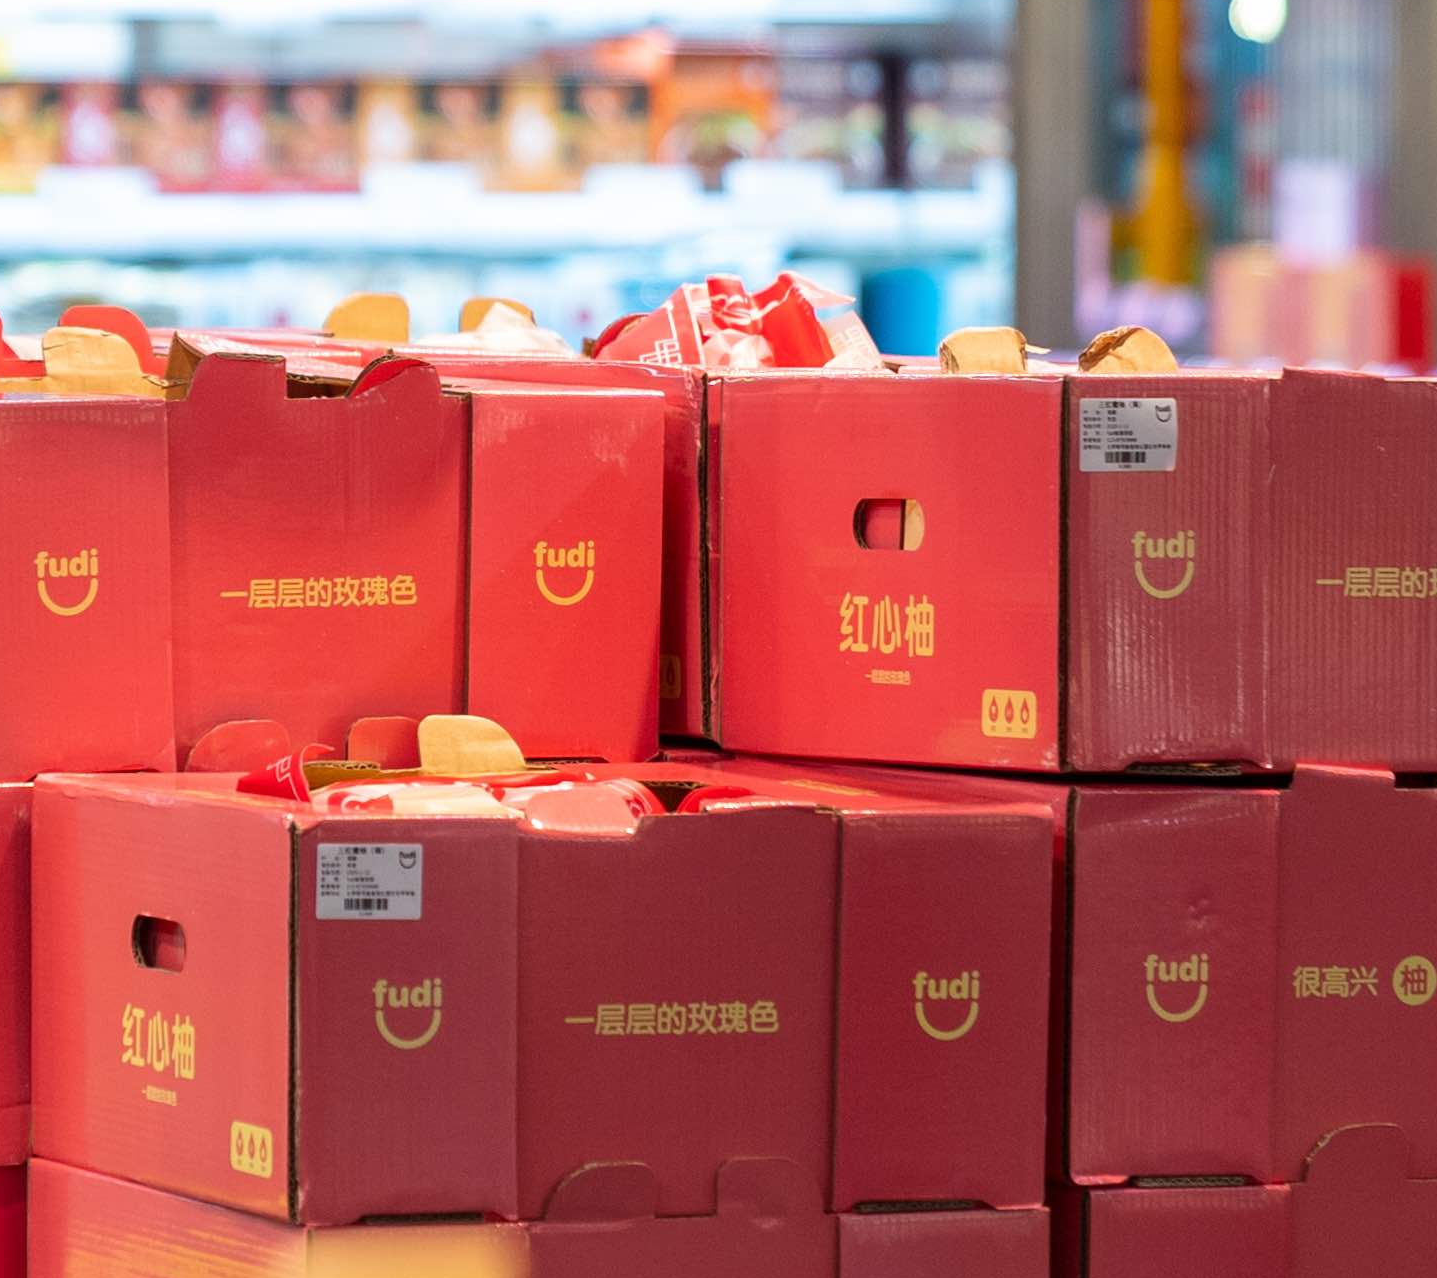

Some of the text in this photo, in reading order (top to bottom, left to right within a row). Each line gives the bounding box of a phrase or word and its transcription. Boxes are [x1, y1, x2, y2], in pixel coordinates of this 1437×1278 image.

[534, 540, 595, 568] fudi
[1131, 530, 1197, 559] fudi
[35, 548, 99, 577] fudi
[220, 576, 418, 609] 一层层的玫瑰色
[839, 591, 935, 658] 红心柚
[1144, 954, 1209, 983] fudi
[1293, 966, 1378, 999] 很高兴
[373, 977, 443, 1009] fudi
[913, 970, 980, 1001] fudi
[564, 1002, 779, 1036] 一层层的玫瑰色
[121, 1002, 196, 1080] 红心柚
